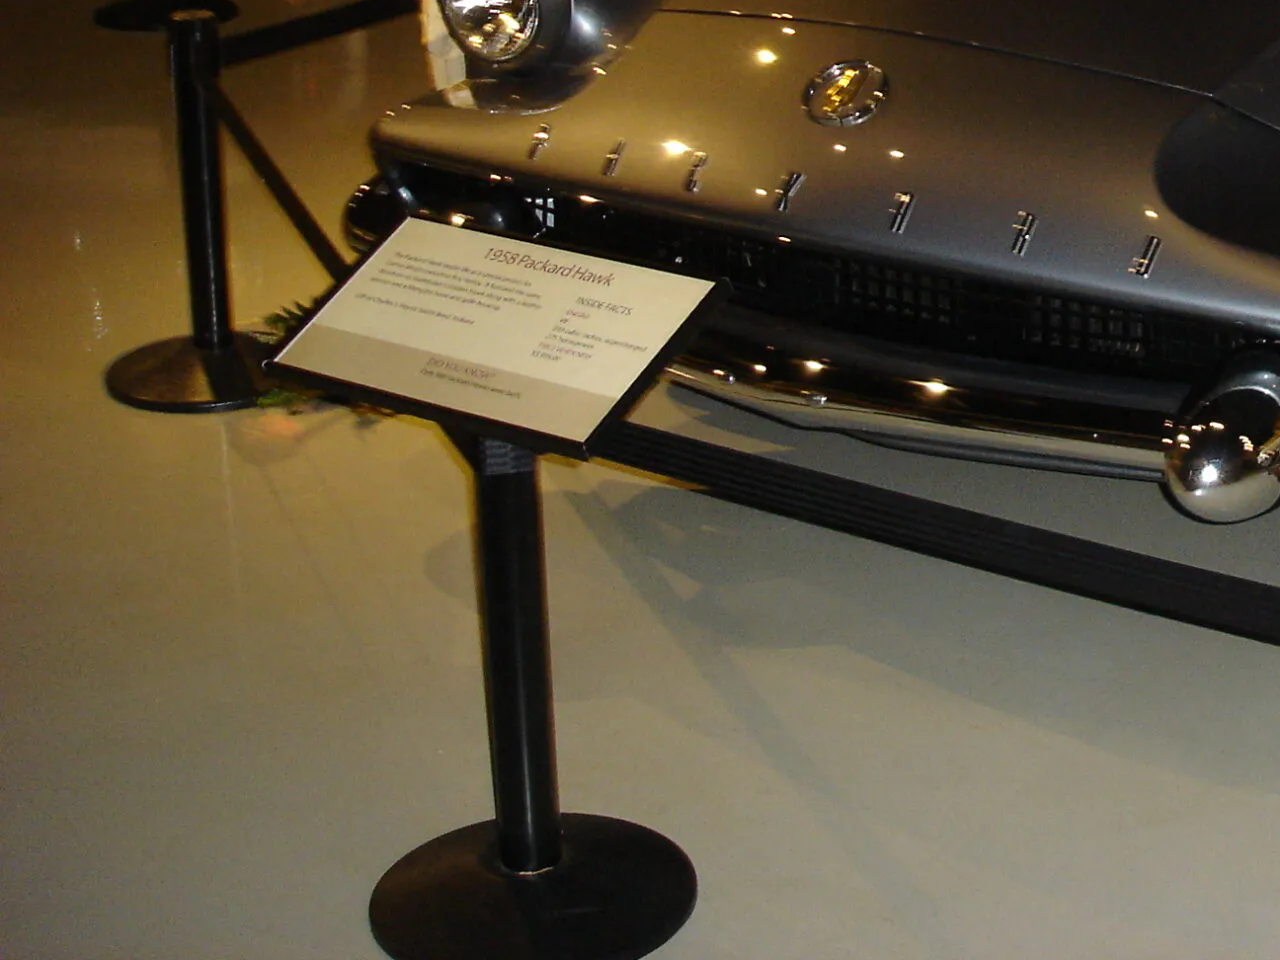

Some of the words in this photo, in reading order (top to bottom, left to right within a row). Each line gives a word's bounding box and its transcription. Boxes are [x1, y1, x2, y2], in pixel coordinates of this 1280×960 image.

[484, 246, 518, 266] 1958
[516, 253, 573, 279] Packard
[571, 262, 616, 288] Hawk
[576, 296, 605, 310] INSIDE
[602, 301, 635, 317] FACTS
